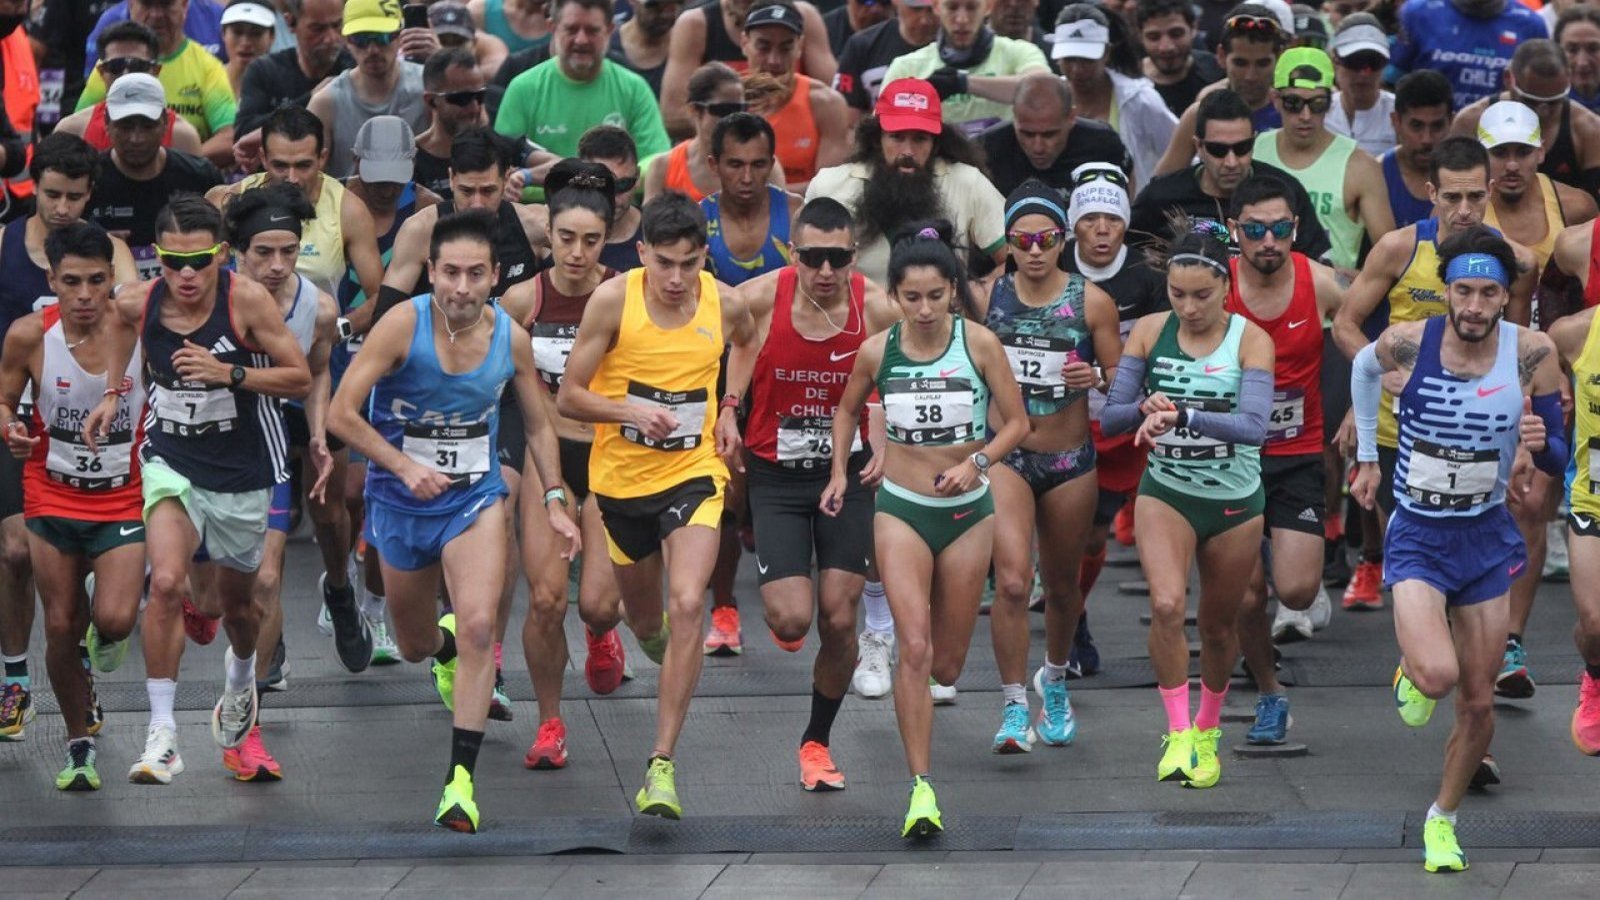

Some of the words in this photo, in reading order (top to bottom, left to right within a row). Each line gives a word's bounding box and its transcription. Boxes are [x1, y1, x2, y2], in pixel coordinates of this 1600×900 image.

[1460, 67, 1499, 88] CHILE
[775, 368, 853, 384] EJERCIT
[1019, 360, 1042, 379] 12
[804, 387, 829, 400] DE
[184, 402, 197, 419] 7
[915, 404, 943, 423] 38
[808, 438, 832, 455] 76
[75, 455, 103, 473] 36
[436, 450, 458, 469] 31
[1447, 472, 1457, 489] 1
